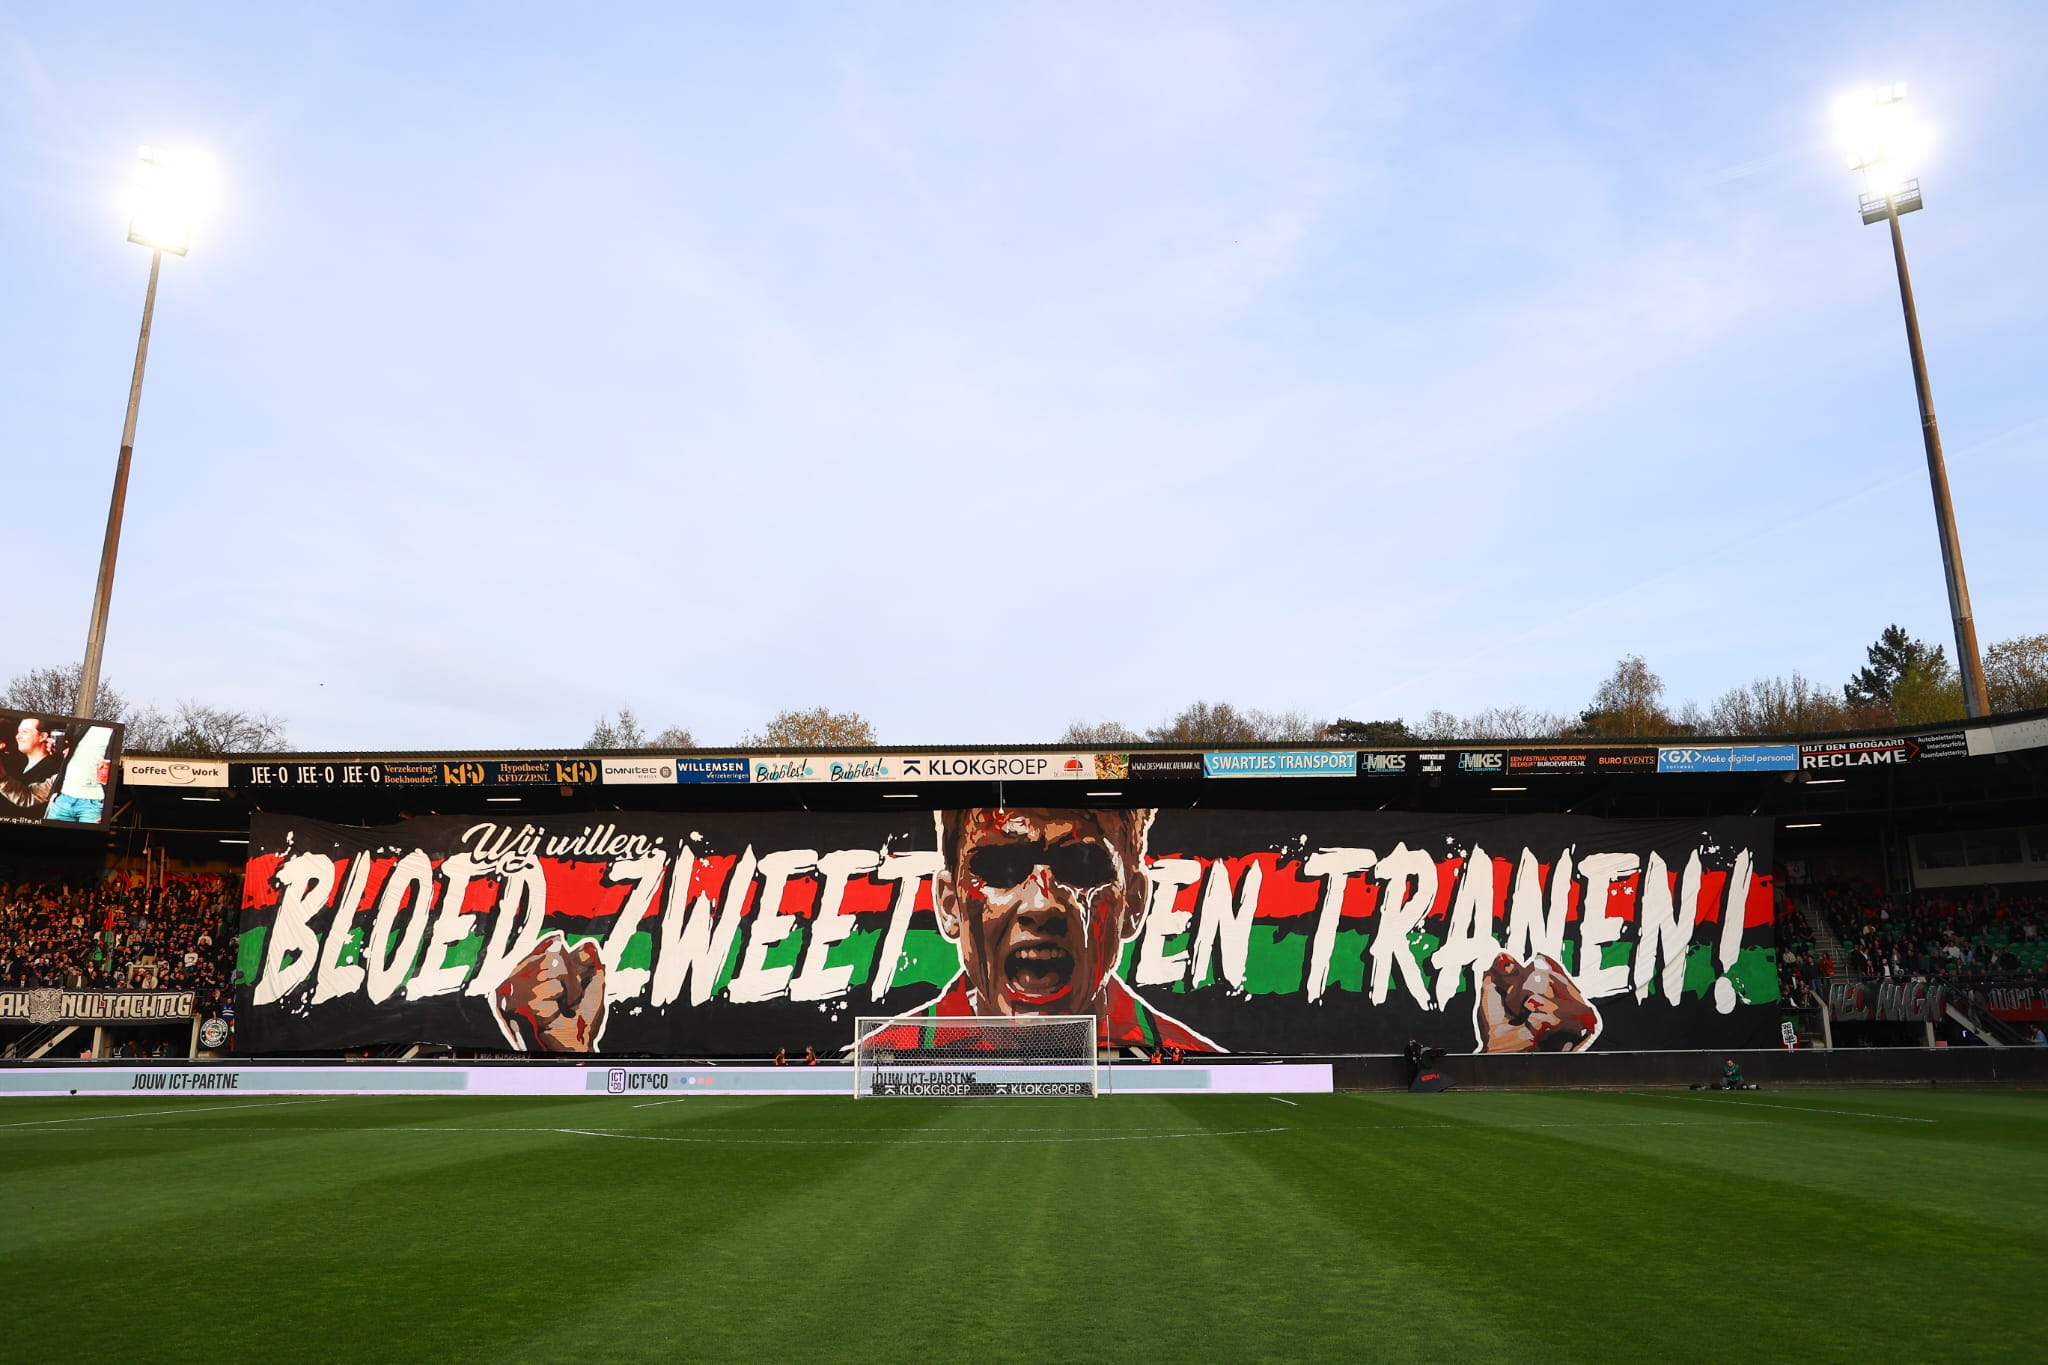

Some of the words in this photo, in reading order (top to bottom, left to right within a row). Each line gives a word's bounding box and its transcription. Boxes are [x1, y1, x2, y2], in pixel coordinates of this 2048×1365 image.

[1802, 744, 1823, 753] UIJT
[1825, 743, 1847, 752] DEN
[1849, 738, 1905, 750] BOOGAARD
[1212, 755, 1276, 770] SWARTJES
[1279, 754, 1355, 769] TRANSPORT
[1368, 754, 1406, 769] MIKES
[1464, 753, 1502, 768] MIKES
[1599, 757, 1622, 765] BURO
[1622, 756, 1656, 765] EVENTS
[1702, 755, 1726, 763] Make
[1728, 754, 1755, 764] digital
[1802, 749, 1908, 769] RECLAME
[131, 766, 167, 775] Coffee
[192, 768, 219, 777] Work
[250, 766, 289, 784] JEE-O
[297, 766, 335, 784] JEE-O
[342, 765, 381, 783] JEE-O
[384, 764, 437, 774] Verzekering?
[500, 763, 550, 773] Hypotheek?
[678, 763, 744, 772] WILLEMSEN
[756, 758, 808, 782] Bubbles!
[831, 757, 883, 782] Bubbles!
[929, 759, 1048, 776] KLOKGROEP
[384, 775, 438, 784] Boekhouder?
[461, 822, 545, 871] Wij
[253, 849, 547, 1006] BLOED
[603, 843, 945, 1008] ZWEET
[1135, 856, 1263, 991] EN
[1303, 841, 1754, 1015] TRANEN!
[60, 992, 193, 1017] NULTACHTIG
[132, 1073, 167, 1090] JOUW
[168, 1073, 239, 1090] ICT-PARTNE
[611, 1072, 623, 1082] ICT
[628, 1073, 668, 1089] ICT&CO
[900, 1084, 971, 1095] KLOKGROEP
[1011, 1084, 1081, 1095] KLOKGROEP
